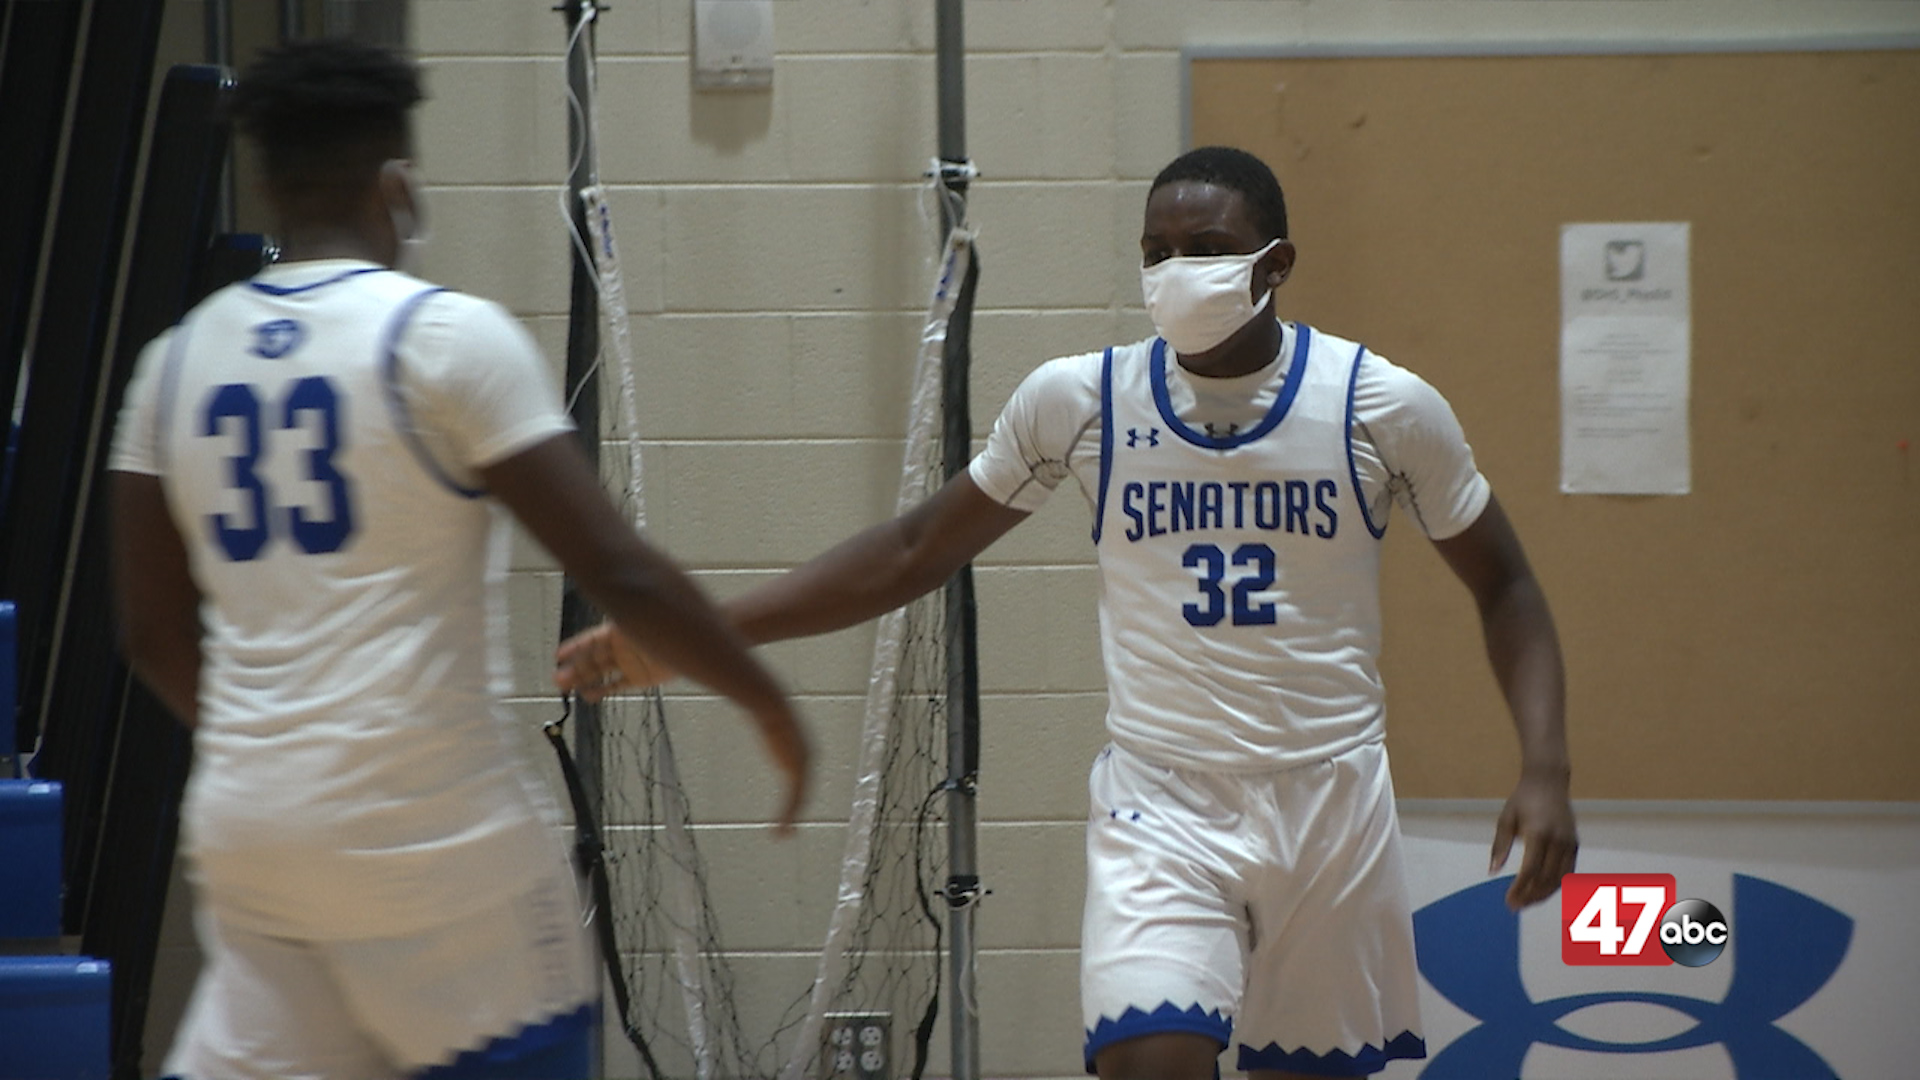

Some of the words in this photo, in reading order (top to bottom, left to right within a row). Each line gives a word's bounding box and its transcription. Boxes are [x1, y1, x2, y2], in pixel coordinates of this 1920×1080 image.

[200, 376, 357, 561] 33
[1122, 479, 1338, 542] SENATORS
[1182, 543, 1277, 627] 32
